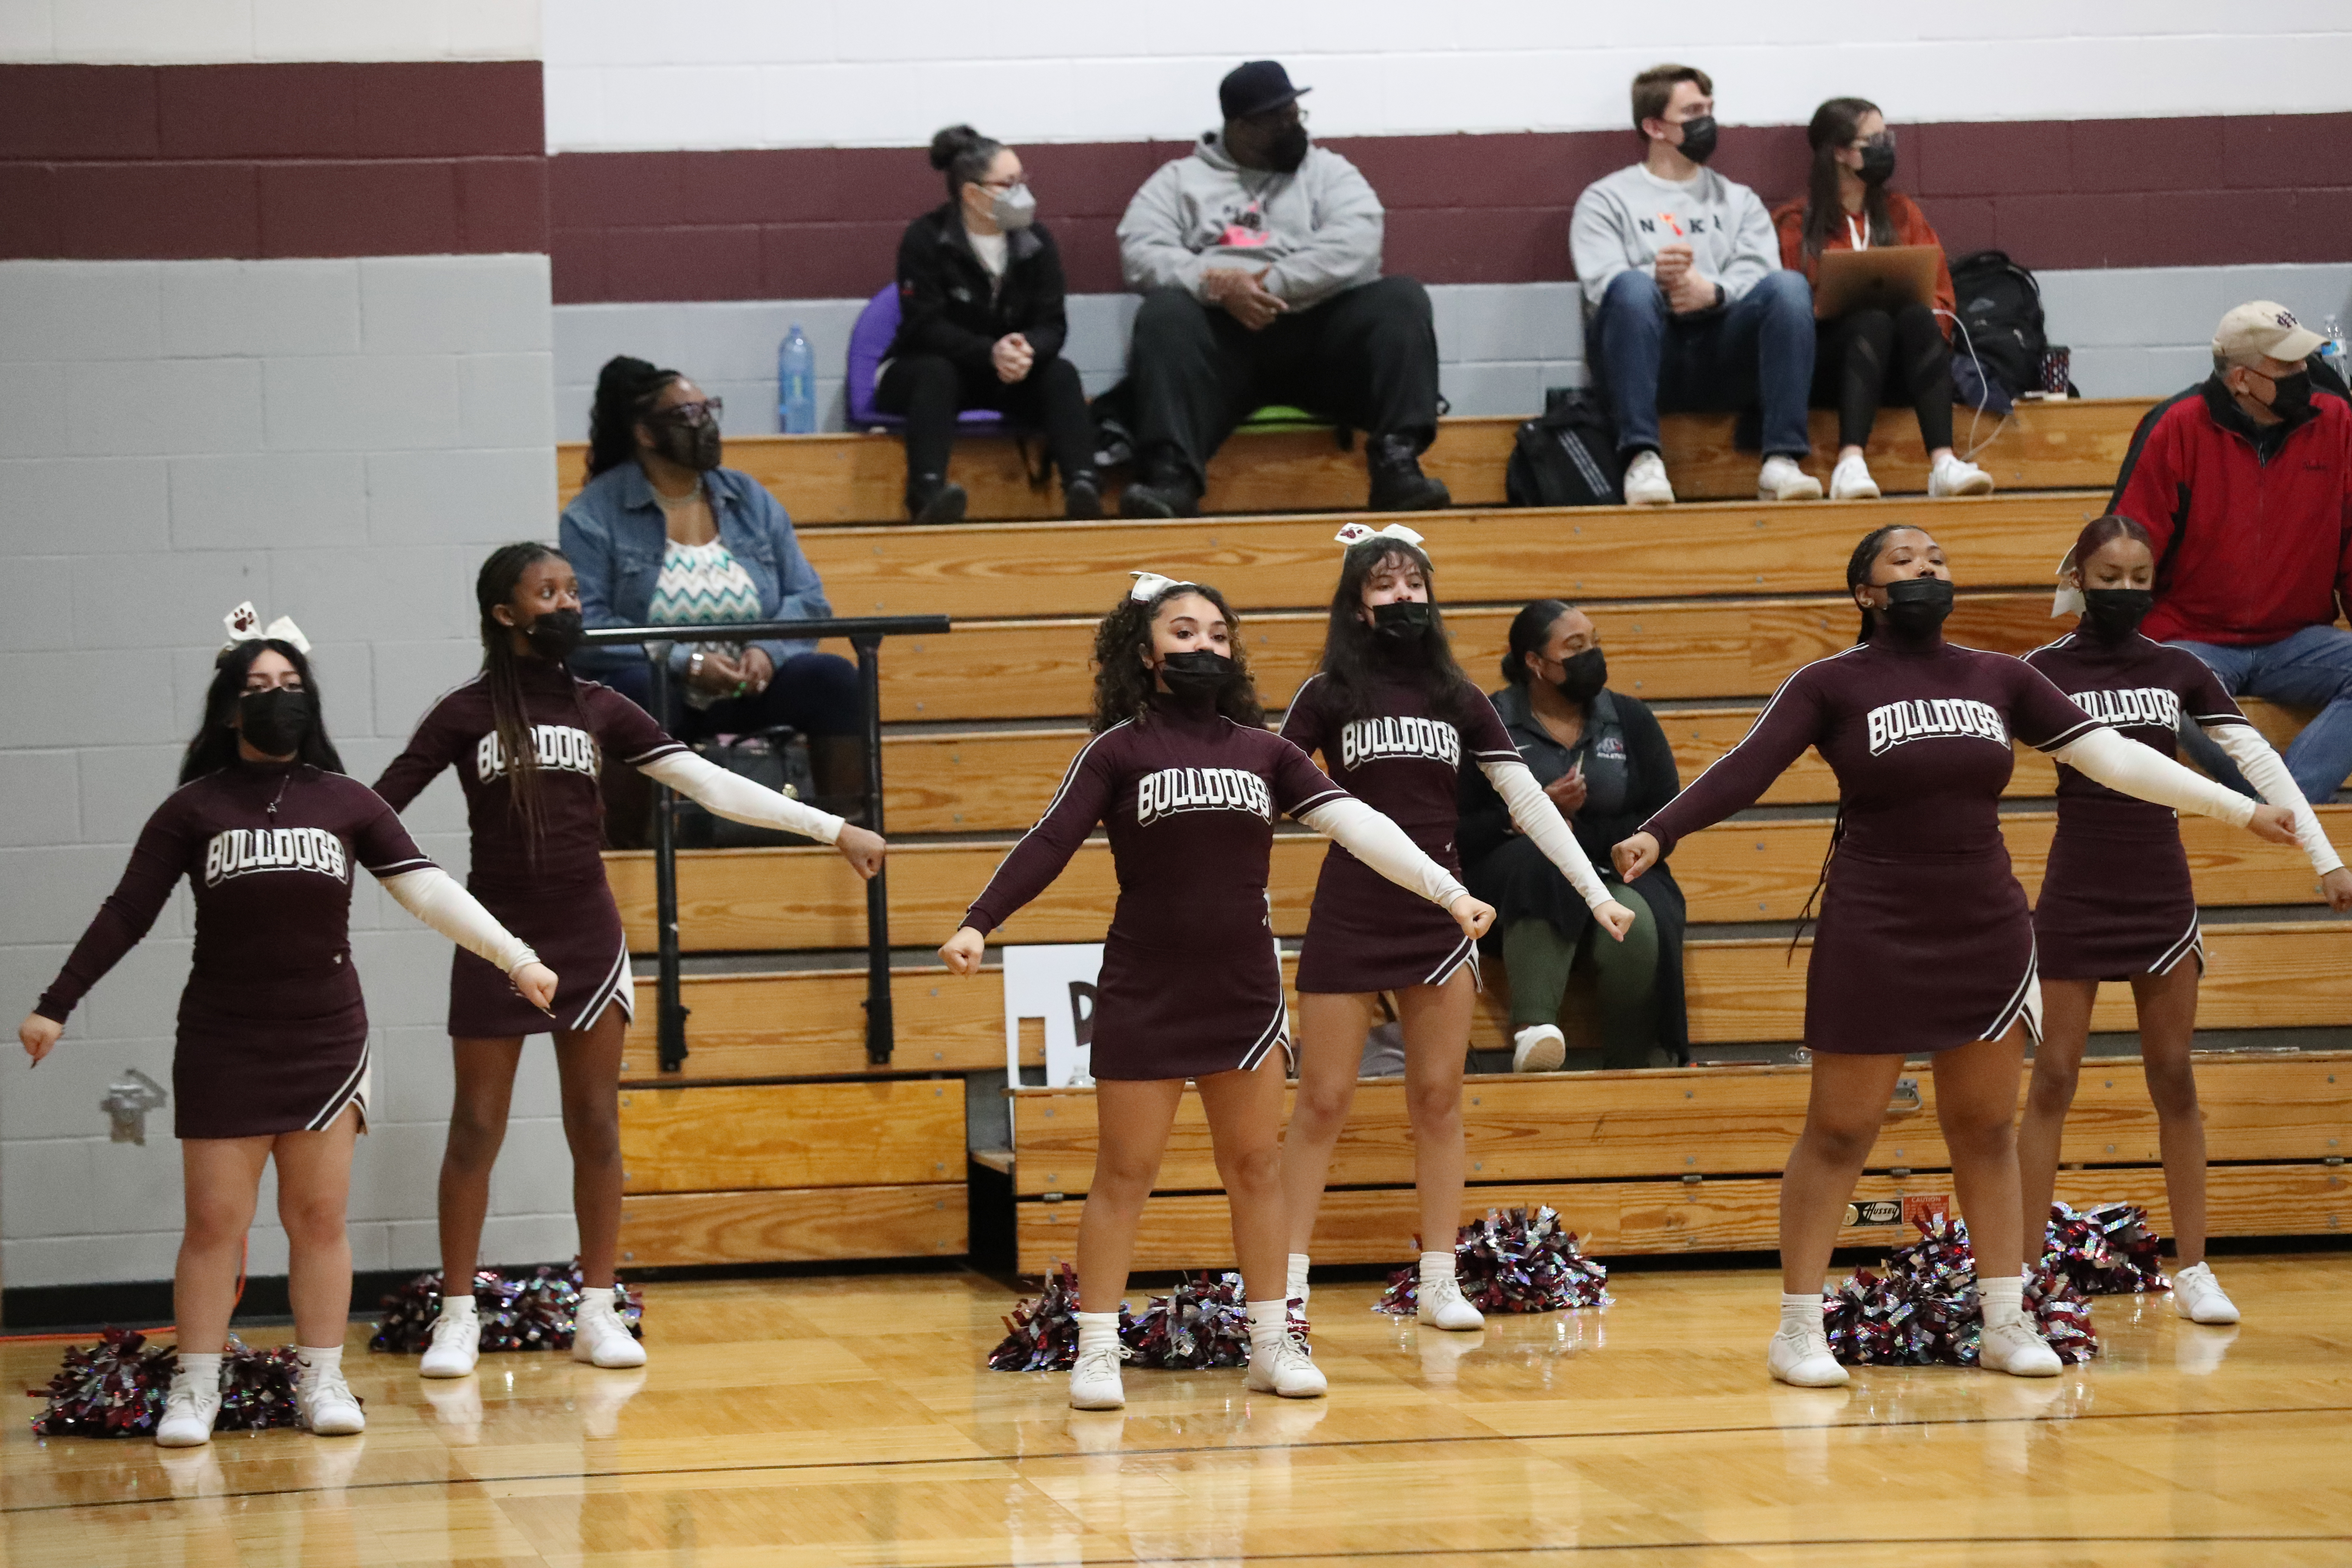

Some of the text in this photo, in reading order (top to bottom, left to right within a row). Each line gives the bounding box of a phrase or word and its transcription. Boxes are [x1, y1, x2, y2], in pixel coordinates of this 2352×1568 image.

[1868, 698, 2011, 756] BULLDOGS
[2069, 687, 2180, 732] ULLDOGS
[478, 725, 601, 784] BUDOGS
[1342, 717, 1461, 773] BULLDOGS
[1138, 768, 1273, 827] BULLDOGS
[205, 828, 349, 888] BULLDOGS
